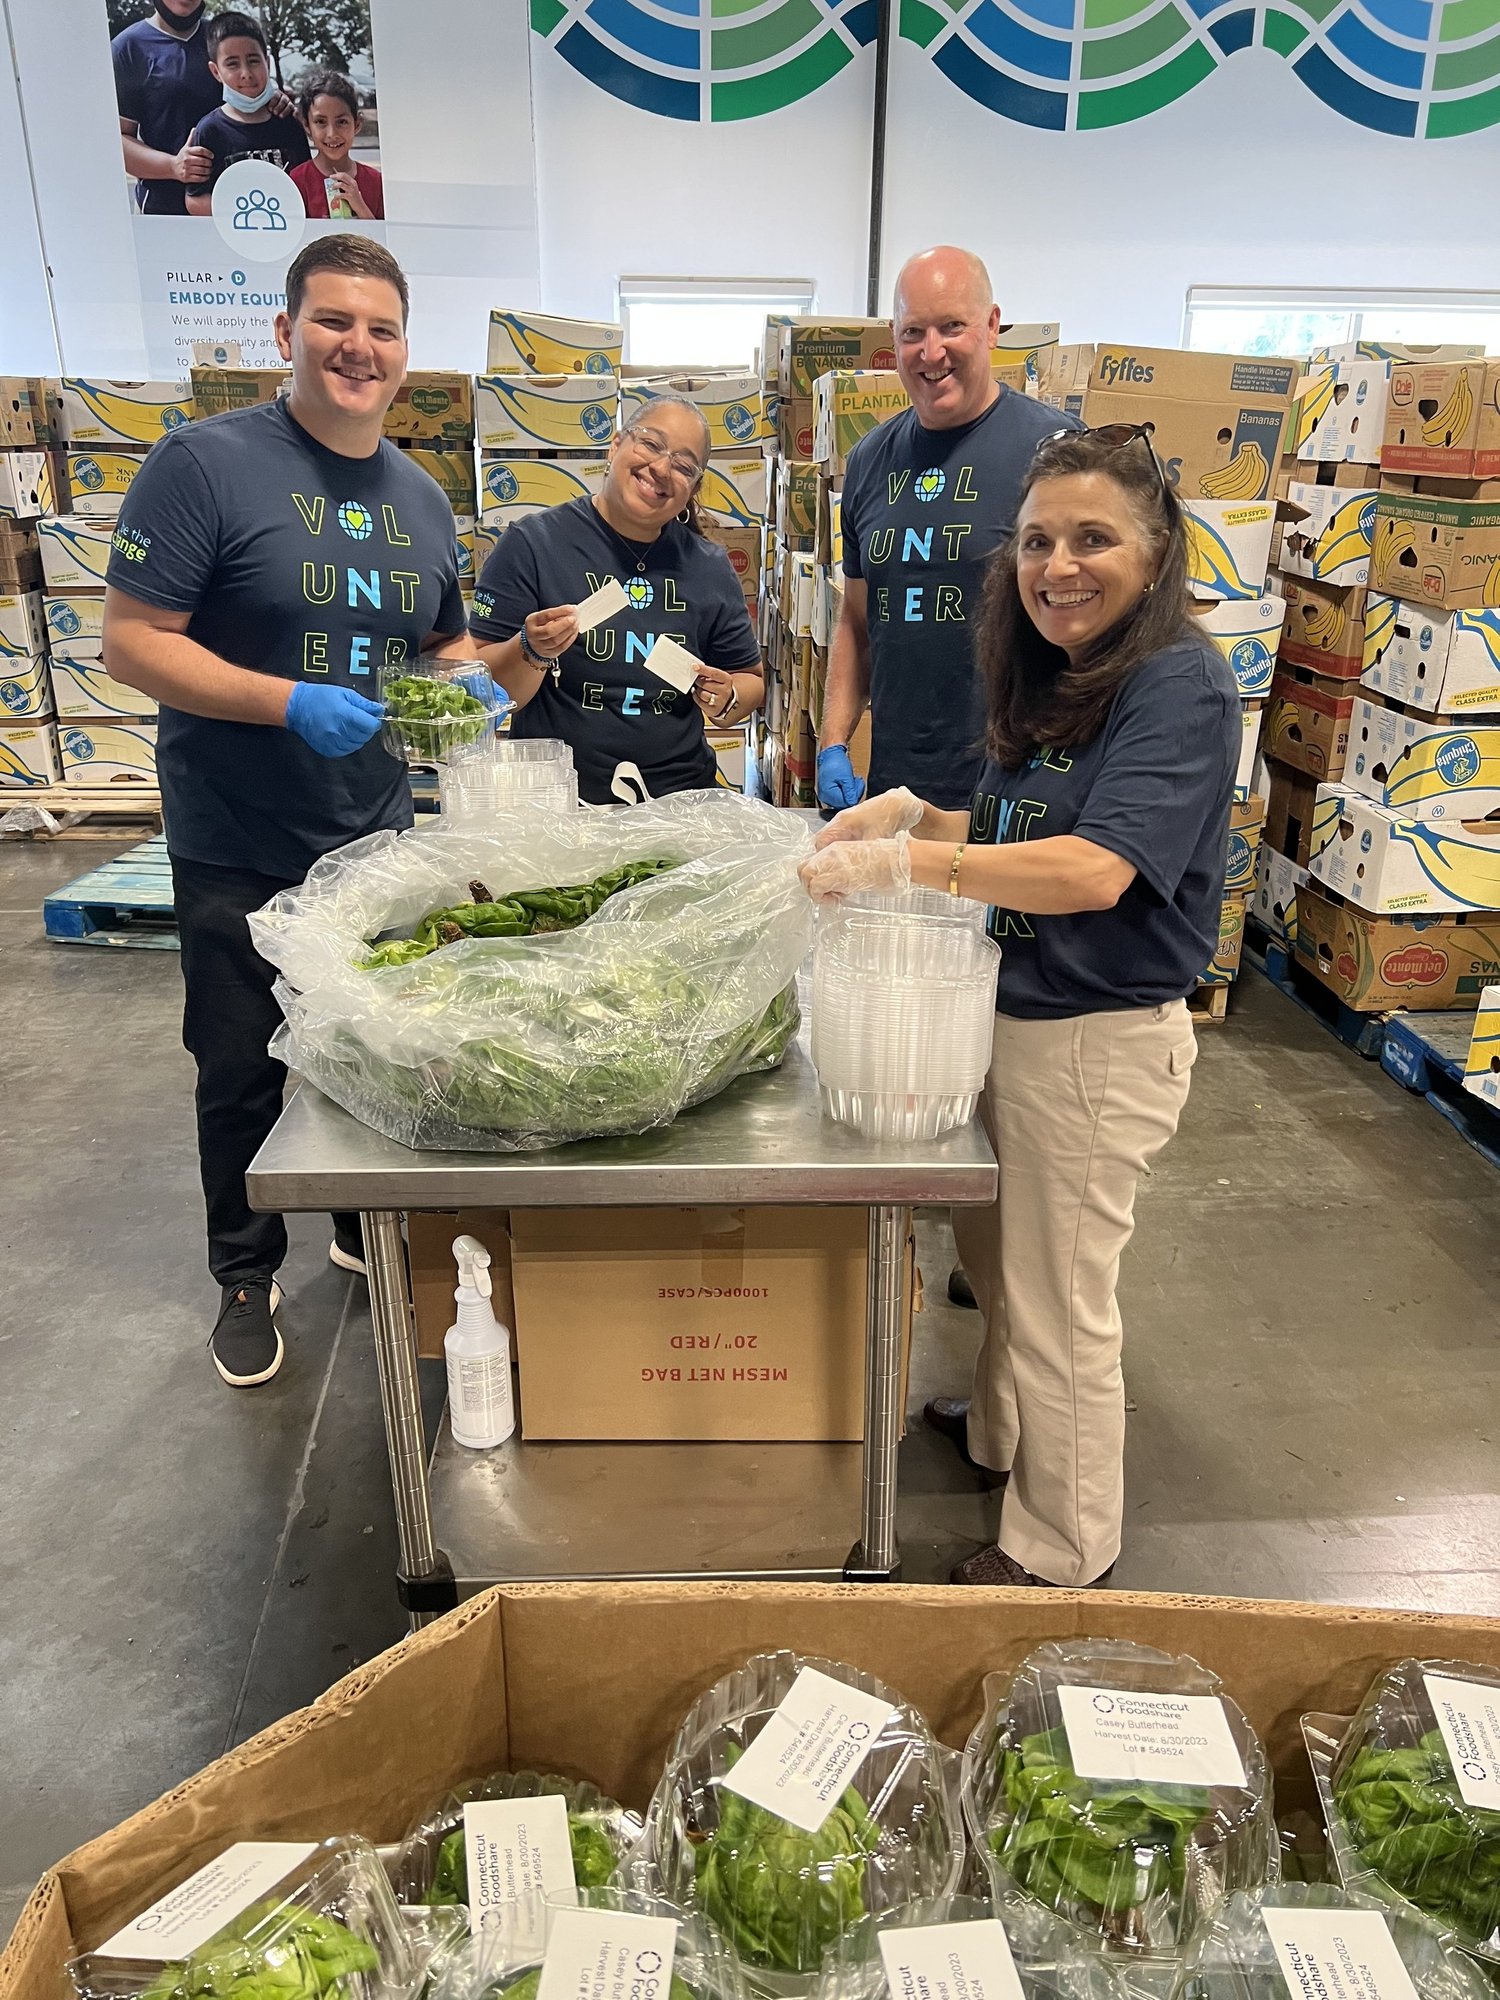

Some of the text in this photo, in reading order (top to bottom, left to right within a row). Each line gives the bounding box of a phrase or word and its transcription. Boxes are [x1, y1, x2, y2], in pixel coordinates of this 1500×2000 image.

[167, 272, 212, 283] PILLAR
[170, 291, 287, 306] EMBODY EQUIT
[172, 315, 269, 328] We will apply the
[797, 344, 846, 354] Premium
[177, 357, 189, 367] to
[255, 357, 267, 367] of
[797, 357, 854, 369] BNANAS
[1100, 355, 1154, 385] fyffes
[1235, 365, 1290, 377] Handle With Care
[194, 385, 244, 395] Premium
[842, 393, 907, 411] PLANTAI
[1240, 412, 1280, 426] Bananas
[1248, 508, 1267, 517] CLASS
[131, 529, 152, 548] the
[1461, 555, 1500, 566] ANIC
[472, 600, 492, 617] ange
[1235, 658, 1272, 684] Chiquita
[1455, 694, 1498, 706] CLASS EXTRA
[1436, 741, 1477, 767] Chiquita
[1226, 845, 1249, 868] iquita
[1389, 898, 1428, 910] CLASS EXTRA
[1386, 961, 1442, 974] Del Monte
[658, 1286, 769, 1299] 1000PCS/CASE
[641, 1367, 788, 1382] MESH NET BAG
[1116, 1697, 1191, 1712] Connecticut
[1120, 1705, 1182, 1720] Foodshare
[816, 1703, 838, 1734] Harvest
[1096, 1717, 1179, 1730] Casey Butterhead
[1094, 1729, 1208, 1746] Harvest Date: 8/30/2023
[1441, 1702, 1469, 1759] Connecticut
[1458, 1712, 1481, 1761] Foodshare
[779, 1737, 802, 1765] 549524
[1123, 1743, 1138, 1753] Lot
[1149, 1747, 1184, 1756] 549524
[811, 1740, 851, 1787] Foodshare
[816, 1743, 861, 1801] Connecticut
[517, 1823, 530, 1868] 8/30/2023
[475, 1833, 490, 1907] Connecticut
[532, 1847, 543, 1881] 549524
[488, 1842, 501, 1905] Foodshare
[504, 1848, 516, 1898] Butterhead
[595, 1940, 613, 1980] Harvest
[613, 1947, 630, 1980] Casey
[1332, 1936, 1367, 2000] te: 8/30/2023
[580, 1967, 593, 1984] Lot
[1285, 1942, 1315, 2000] nnecticut
[1324, 1962, 1347, 1999] terhead
[970, 1979, 985, 2000] 524
